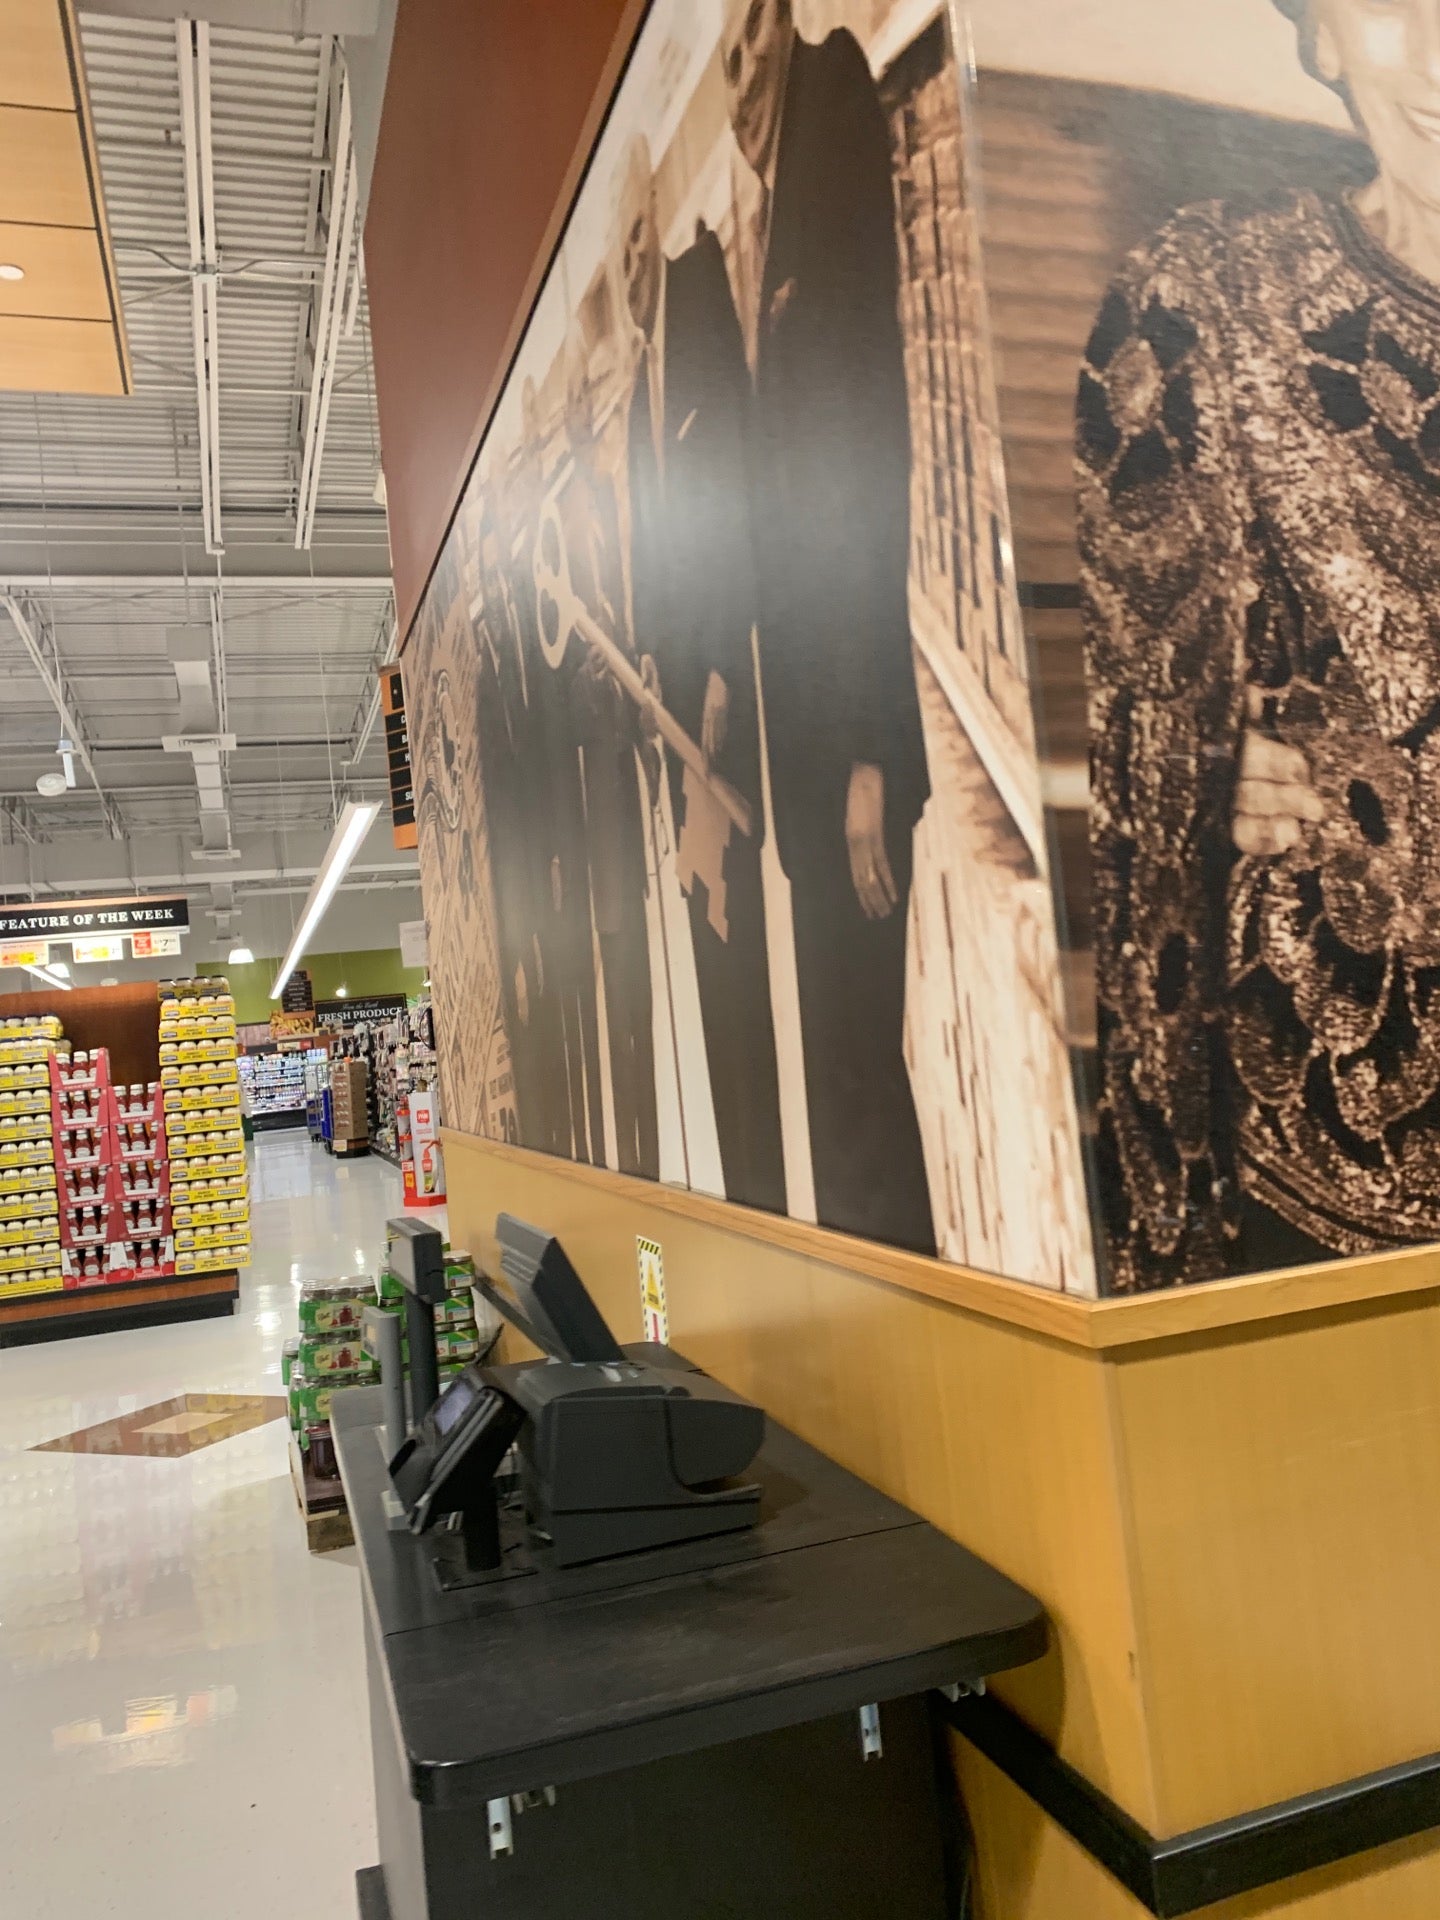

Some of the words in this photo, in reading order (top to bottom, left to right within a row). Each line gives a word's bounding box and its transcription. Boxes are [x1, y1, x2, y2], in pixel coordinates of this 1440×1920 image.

[0, 915, 69, 930] FEATURE
[73, 913, 94, 925] OF
[97, 911, 128, 924] THE
[131, 908, 174, 921] WEEK
[318, 1011, 351, 1022] FRESH
